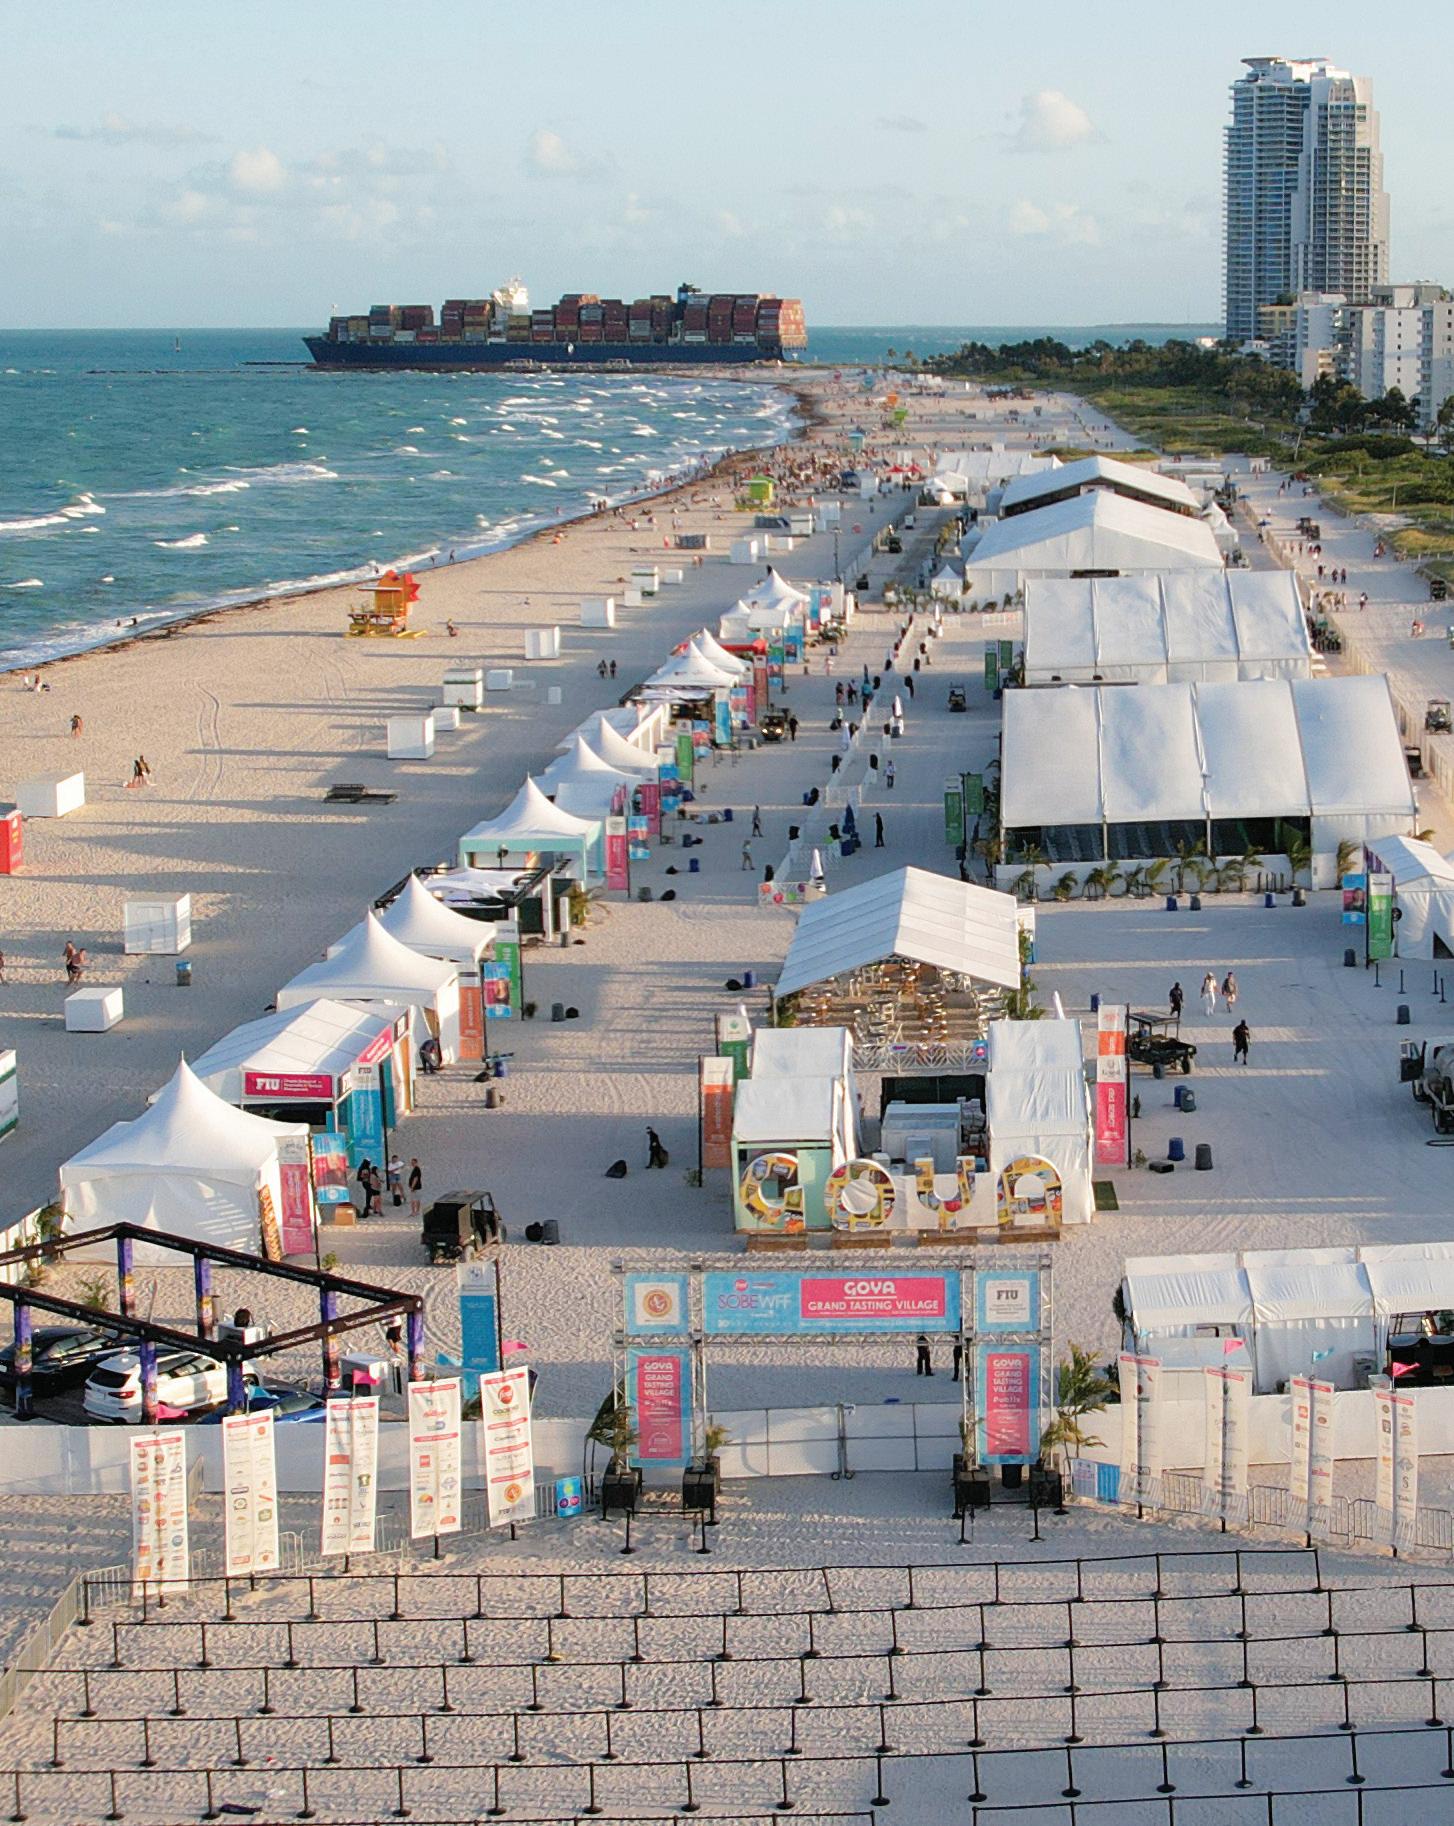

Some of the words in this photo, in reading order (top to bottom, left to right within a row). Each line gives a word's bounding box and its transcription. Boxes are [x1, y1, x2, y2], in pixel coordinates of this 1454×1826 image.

[255, 1077, 280, 1091] FIU
[740, 1152, 1063, 1235] GOYA
[843, 1280, 896, 1296] GOYA
[996, 1289, 1019, 1300] FIU
[807, 1301, 847, 1311] GRAND
[849, 1300, 892, 1311] TASTING
[895, 1299, 939, 1310] VILLAGE
[644, 1361, 673, 1371] GOYA
[993, 1359, 1022, 1368] GOYA
[994, 1370, 1022, 1378] GRAND
[644, 1389, 674, 1397] VILLAGE
[993, 1385, 1023, 1393] VILLAGE
